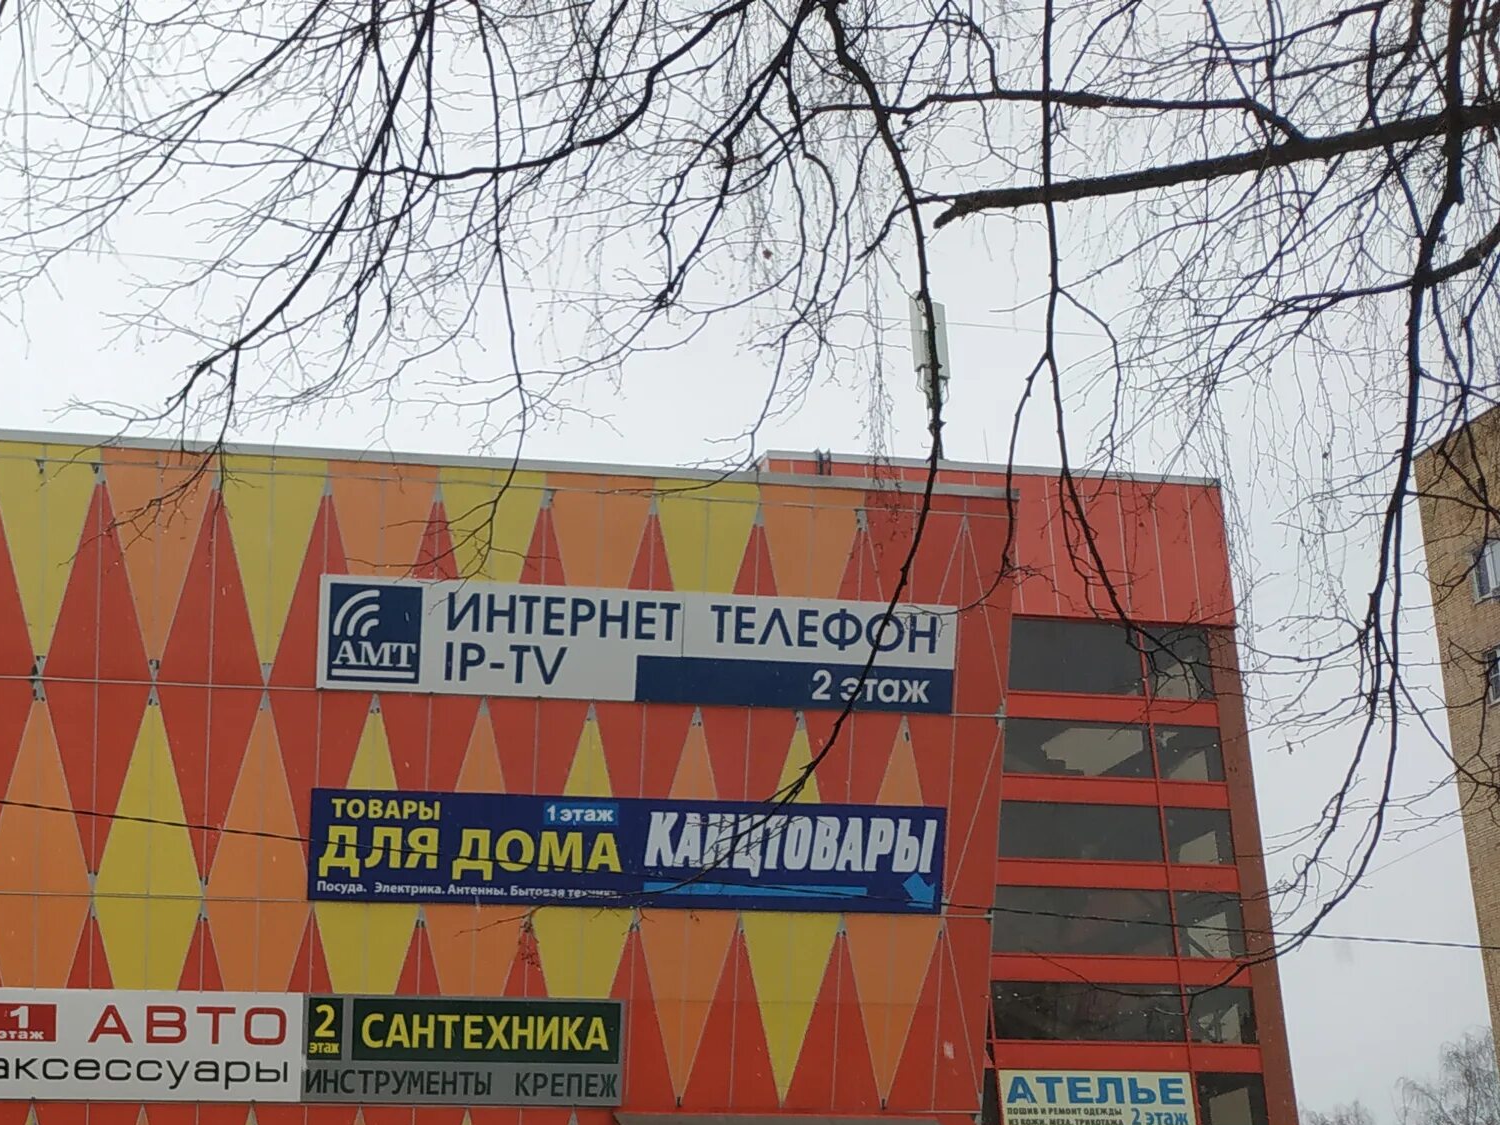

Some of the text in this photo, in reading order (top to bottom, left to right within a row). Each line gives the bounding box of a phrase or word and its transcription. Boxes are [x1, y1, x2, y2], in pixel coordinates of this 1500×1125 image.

[446, 591, 938, 654] ИНТЕРНЕТ ТЕЛЕФОН
[444, 641, 567, 685] IP-TV
[811, 669, 930, 703] 2 этаж
[332, 798, 441, 821] ТОВАРЫ
[547, 806, 614, 823] 1 этаж
[318, 825, 623, 880] ДЛЯ ДОМА
[644, 811, 938, 878] КАНЦТОВАРЫ
[316, 880, 367, 894] Посуда.
[374, 882, 445, 896] Электрика.
[447, 884, 508, 897] Антенны.
[10, 1004, 287, 1045] 1 АВТО
[314, 1004, 609, 1051] 2 САНТЕХНИКА
[309, 1042, 340, 1054] этаж
[305, 1069, 618, 1097] ИНСТРУМЕНТЫ КРЕПЕЖ
[1007, 1076, 1186, 1105] АТЕЛЬЕ
[1131, 1108, 1142, 1125] 2
